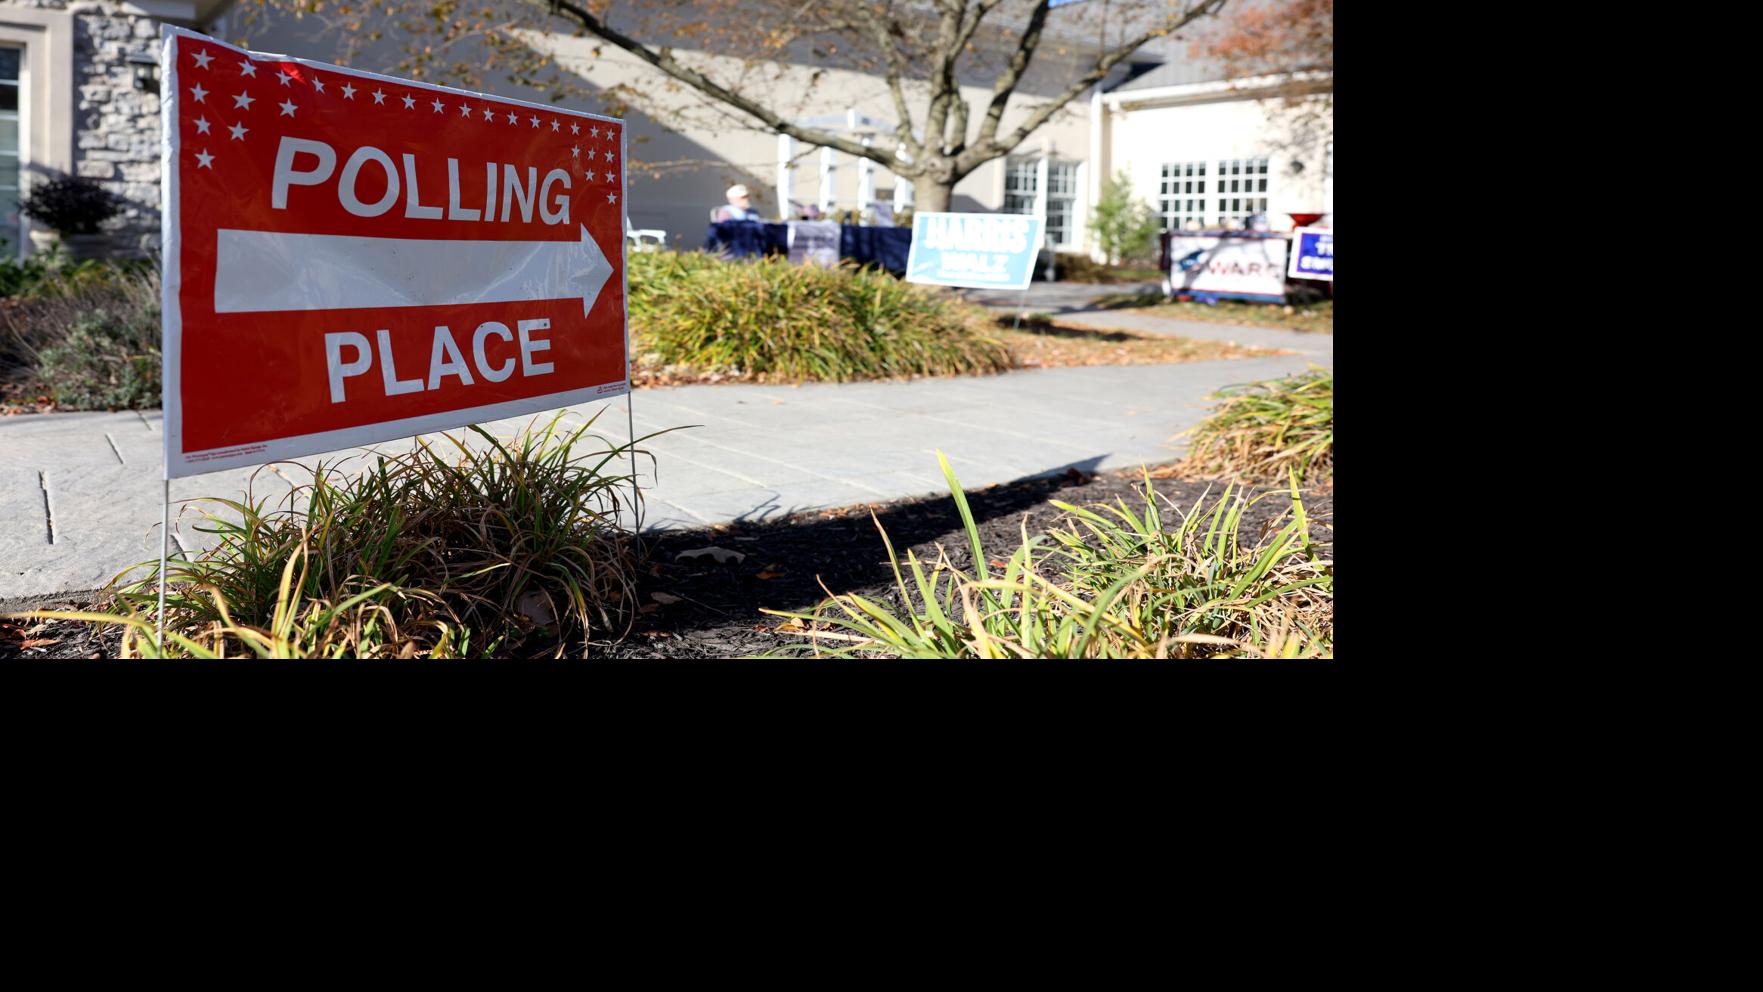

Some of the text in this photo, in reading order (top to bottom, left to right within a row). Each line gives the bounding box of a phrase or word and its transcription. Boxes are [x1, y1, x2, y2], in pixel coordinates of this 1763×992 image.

[273, 137, 572, 225] POLLING
[926, 216, 1028, 253] HARRIS
[941, 251, 1009, 272] WALZ
[325, 319, 554, 403] PLACE
